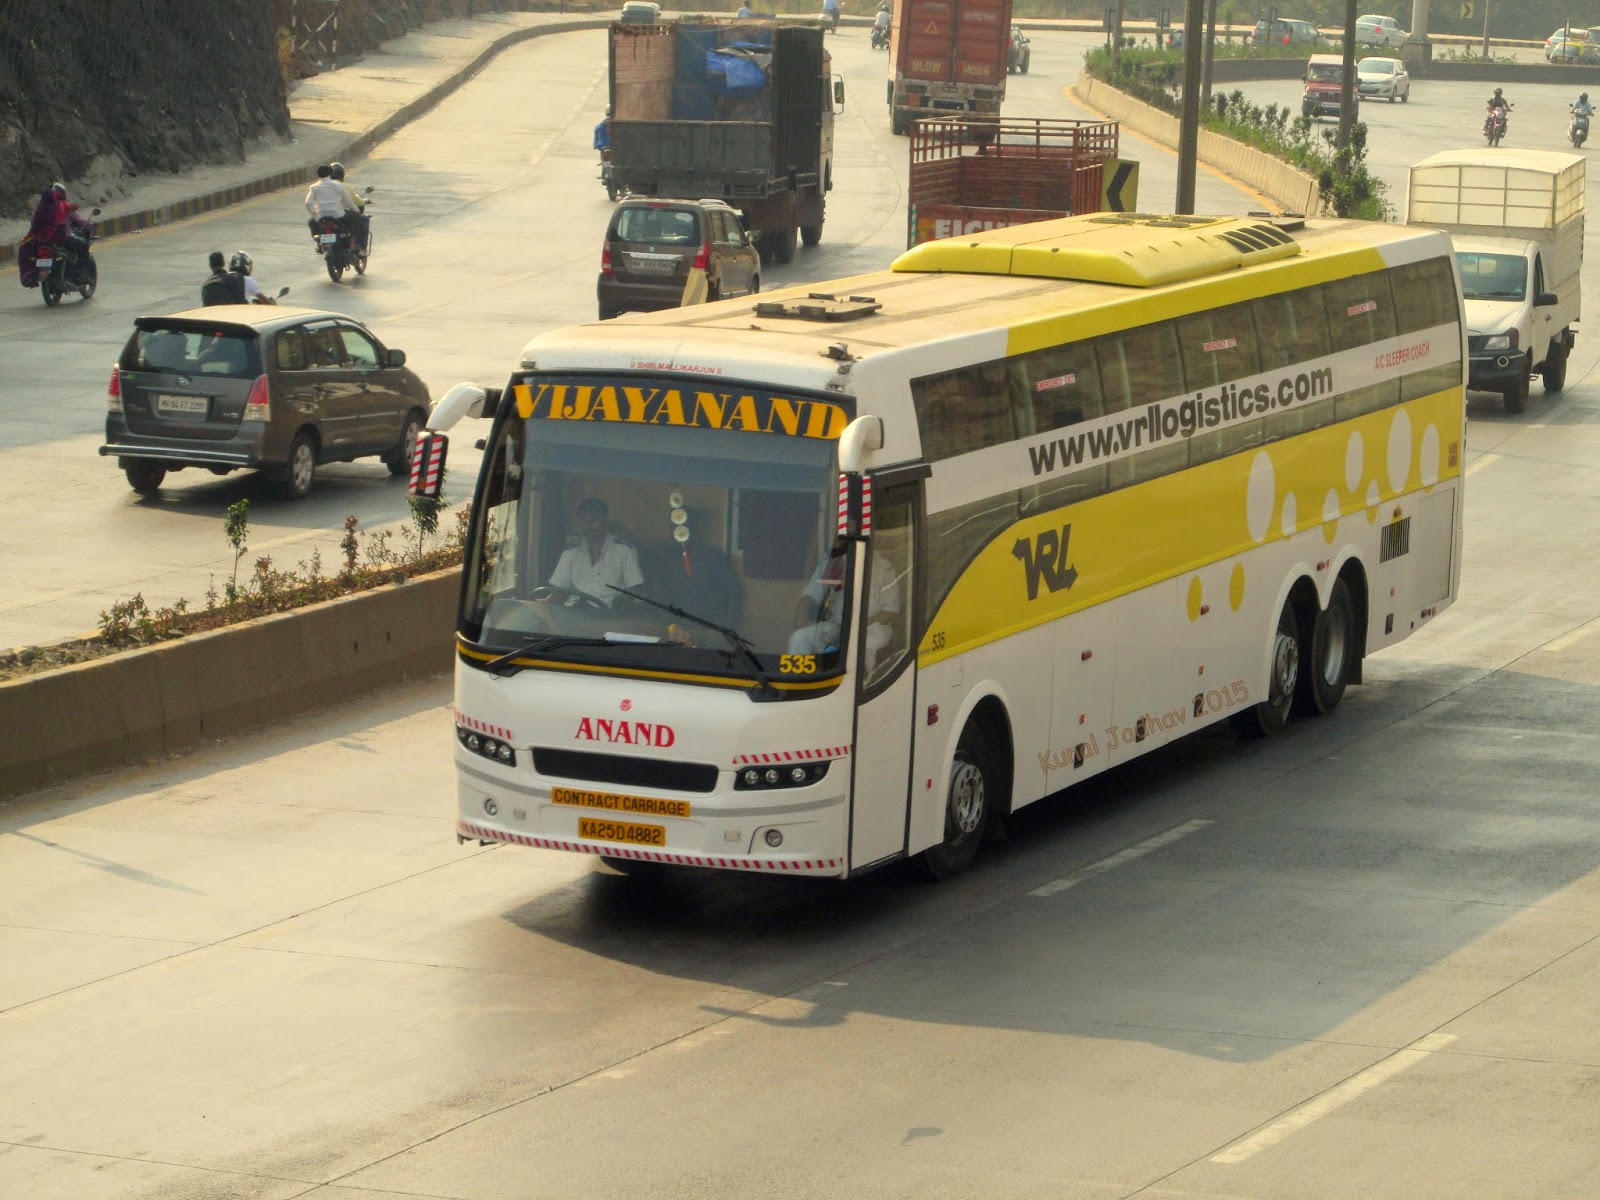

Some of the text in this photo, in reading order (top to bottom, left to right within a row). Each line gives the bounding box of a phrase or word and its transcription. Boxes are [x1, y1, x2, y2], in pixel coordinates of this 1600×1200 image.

[912, 60, 941, 74] BLOW
[1385, 347, 1409, 368] SLEEPER
[1411, 341, 1430, 360] COACH
[512, 384, 848, 440] VIJAYANAND
[1028, 365, 1334, 476] www.vrllogistics.com
[932, 631, 945, 651] 535
[779, 654, 817, 674] 535
[574, 717, 675, 748] ANAND
[554, 789, 686, 817] CONTRACT CARRIAGE
[581, 821, 662, 844] KA25D4882
